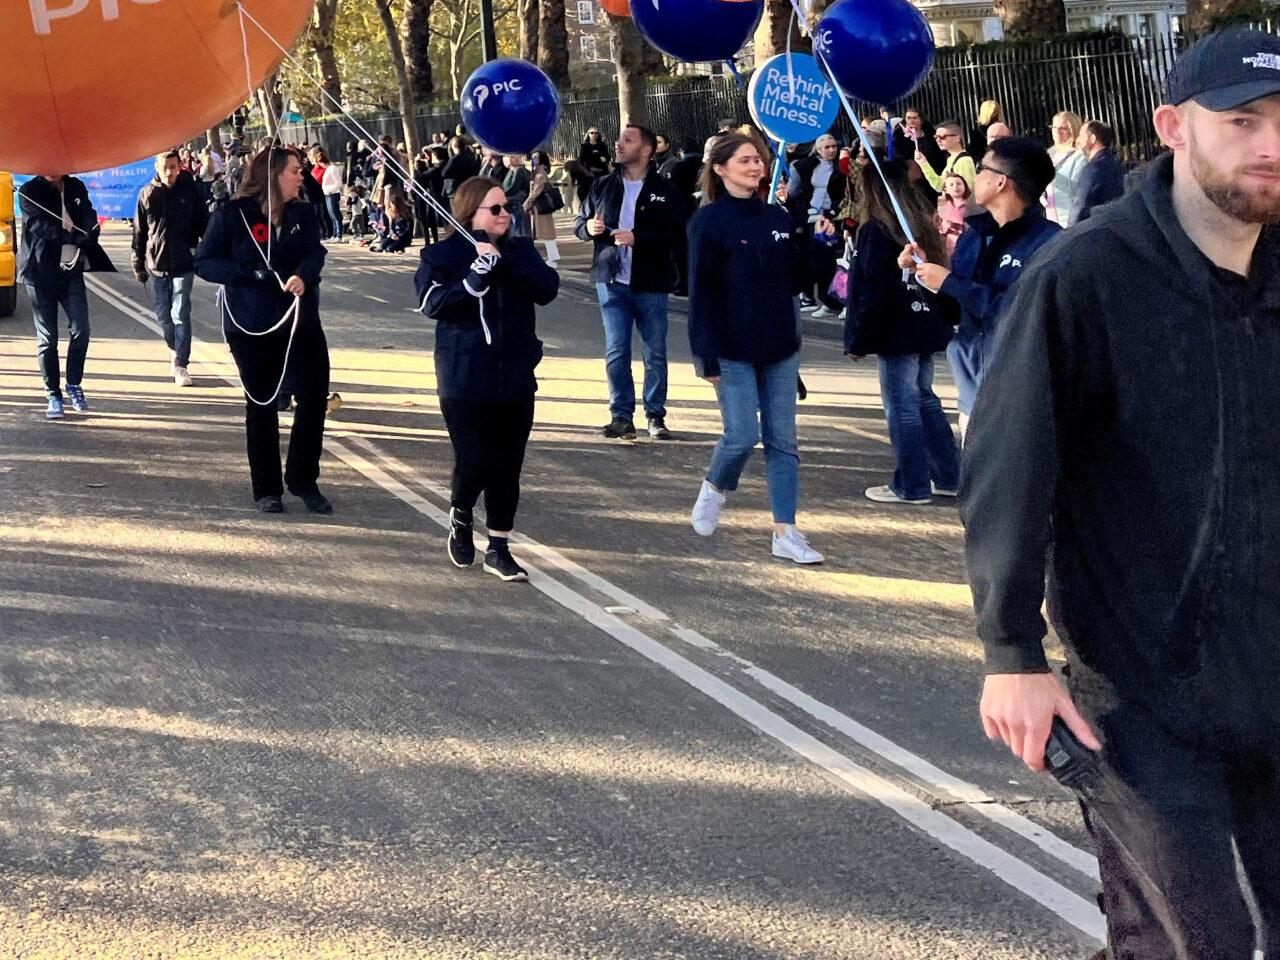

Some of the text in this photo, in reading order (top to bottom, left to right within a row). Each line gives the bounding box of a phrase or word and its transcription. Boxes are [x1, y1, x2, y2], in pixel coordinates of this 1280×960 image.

[493, 79, 522, 96] PIC
[763, 83, 824, 113] Mental
[760, 98, 821, 128] Illness.
